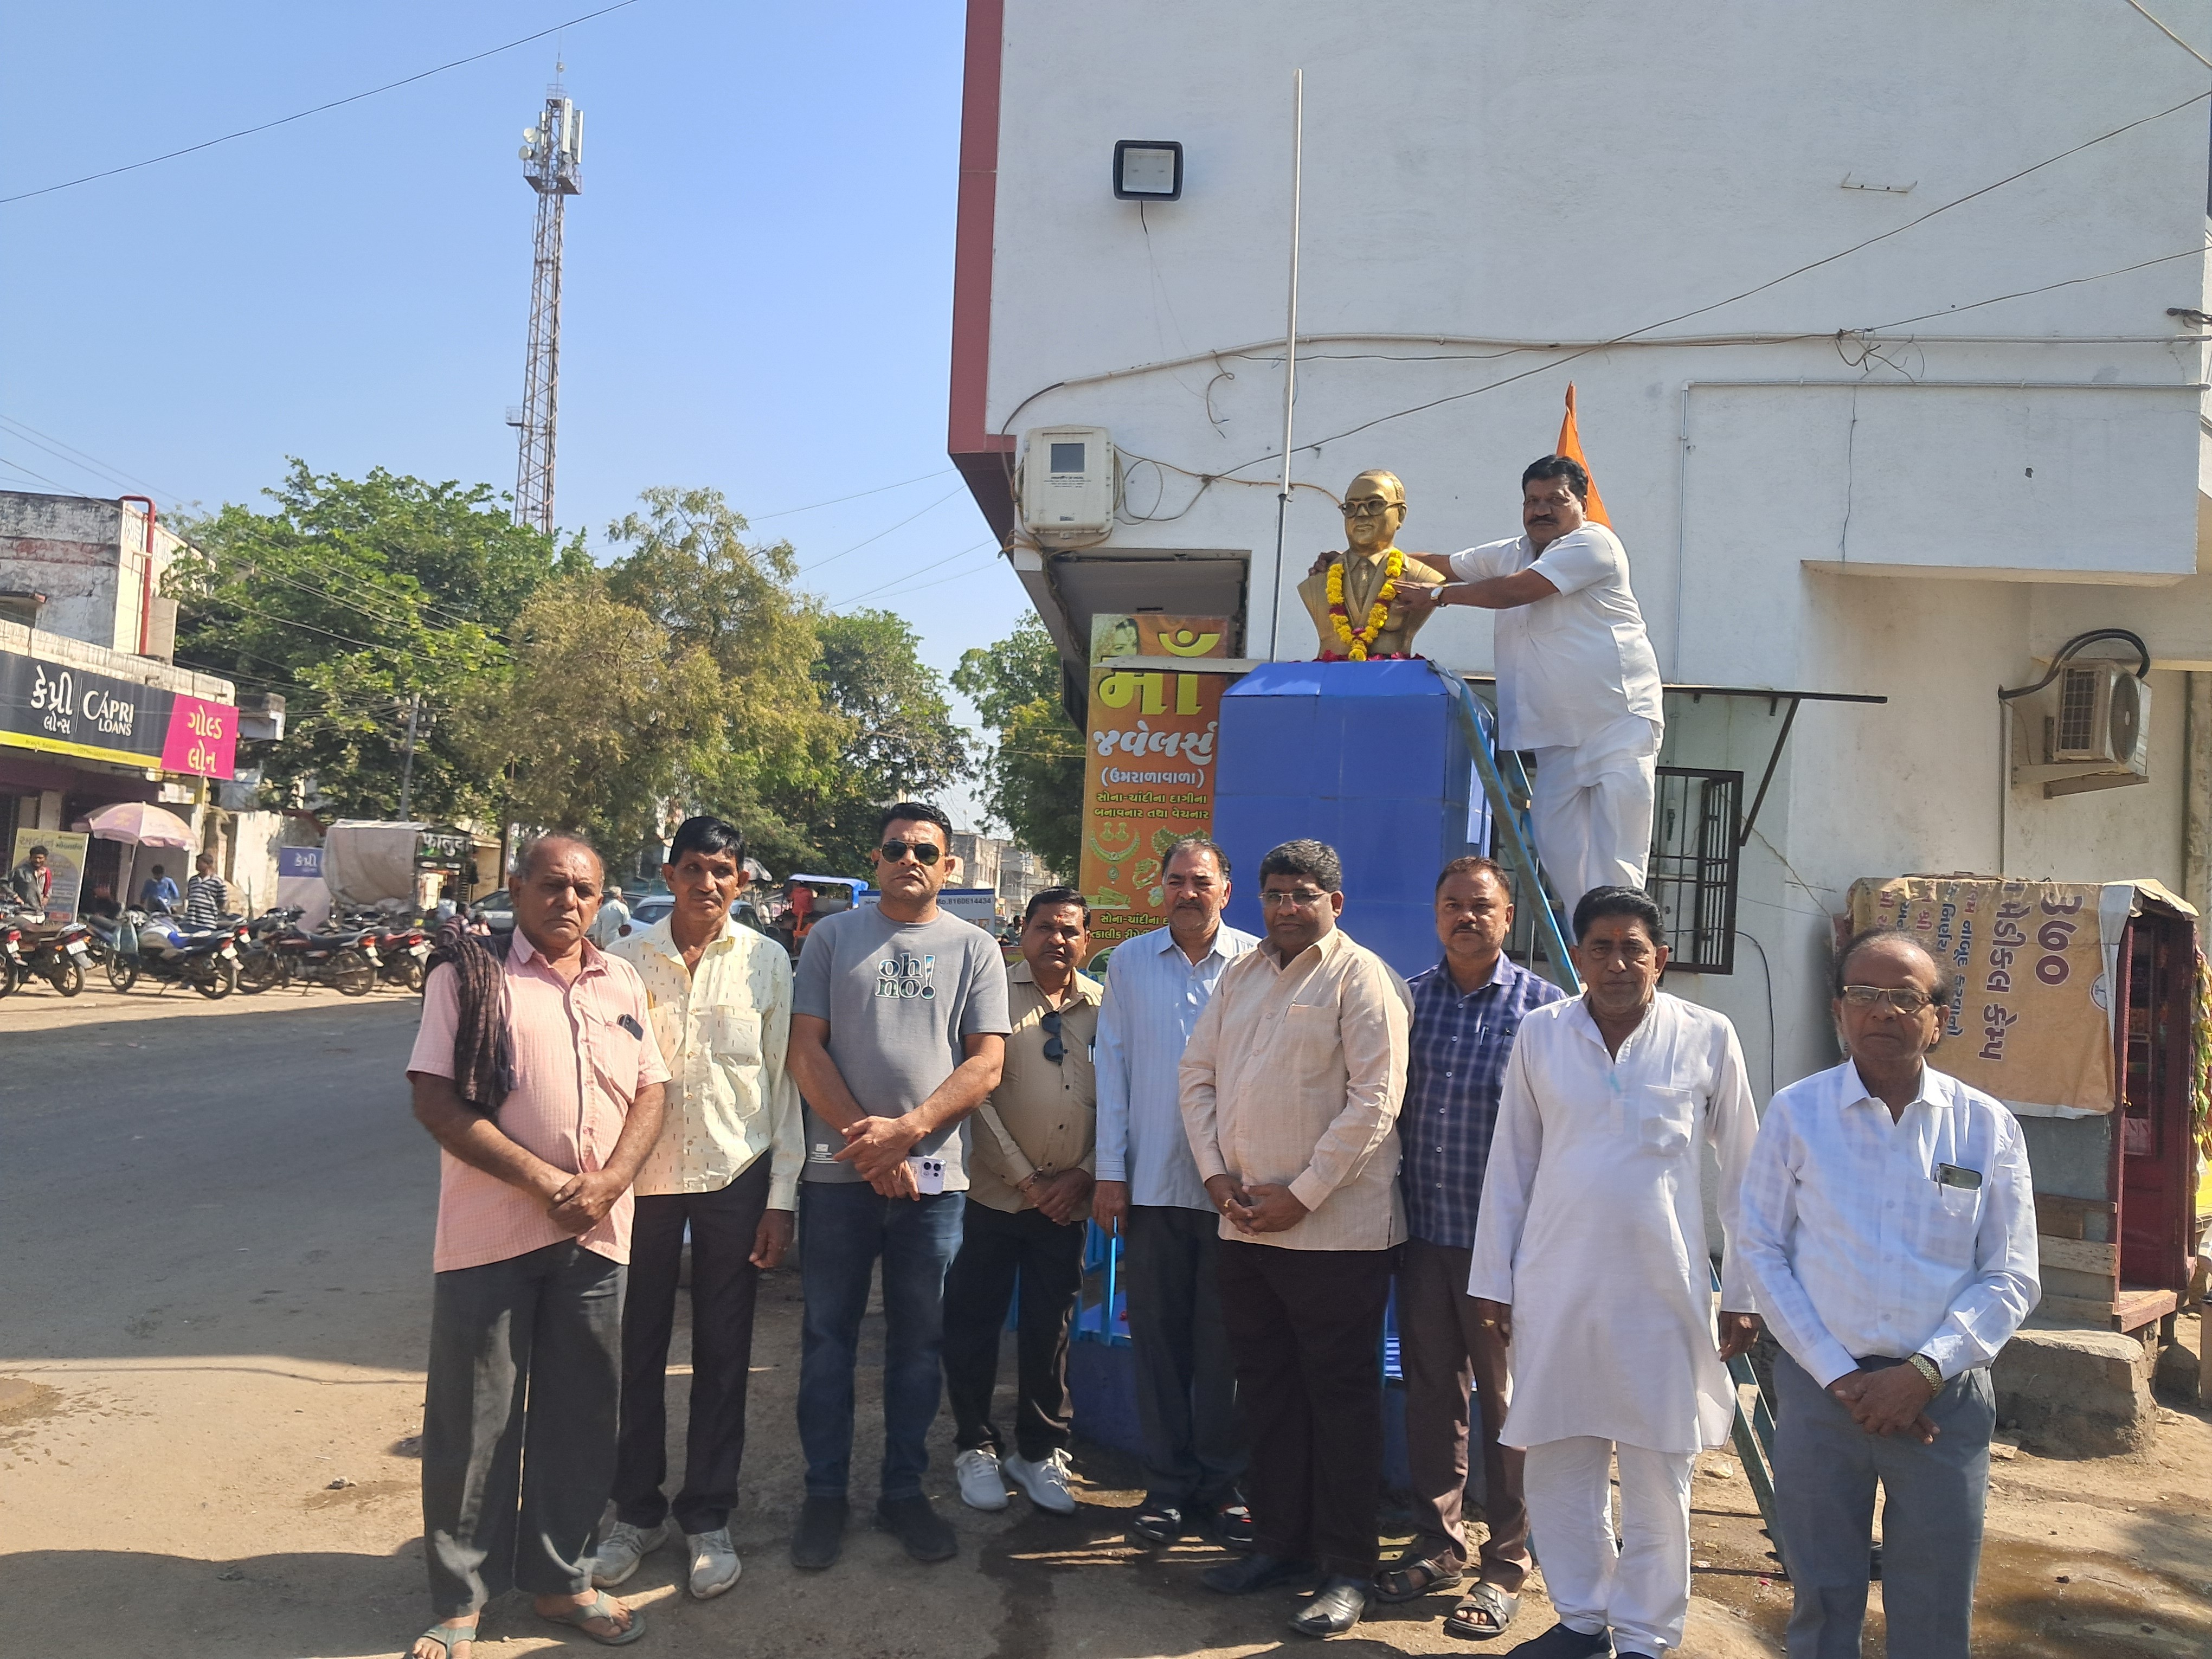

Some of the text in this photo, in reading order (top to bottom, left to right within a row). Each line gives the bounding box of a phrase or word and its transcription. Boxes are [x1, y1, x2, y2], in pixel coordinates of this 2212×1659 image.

[30, 664, 73, 716] કેપ્રી
[83, 690, 135, 724] CAPRI
[43, 711, 72, 735] લોન્સ
[98, 718, 133, 737] LOANS
[187, 704, 223, 740] ગોલ્ડ
[187, 738, 217, 774] લોન
[1094, 807, 1210, 819] બનાવનાર તથા વેચનાર
[1169, 792, 1207, 805] દાગીના
[1964, 885, 1979, 914] લમ
[878, 952, 923, 979] oh
[1979, 1003, 2019, 1061] કેમ્પ
